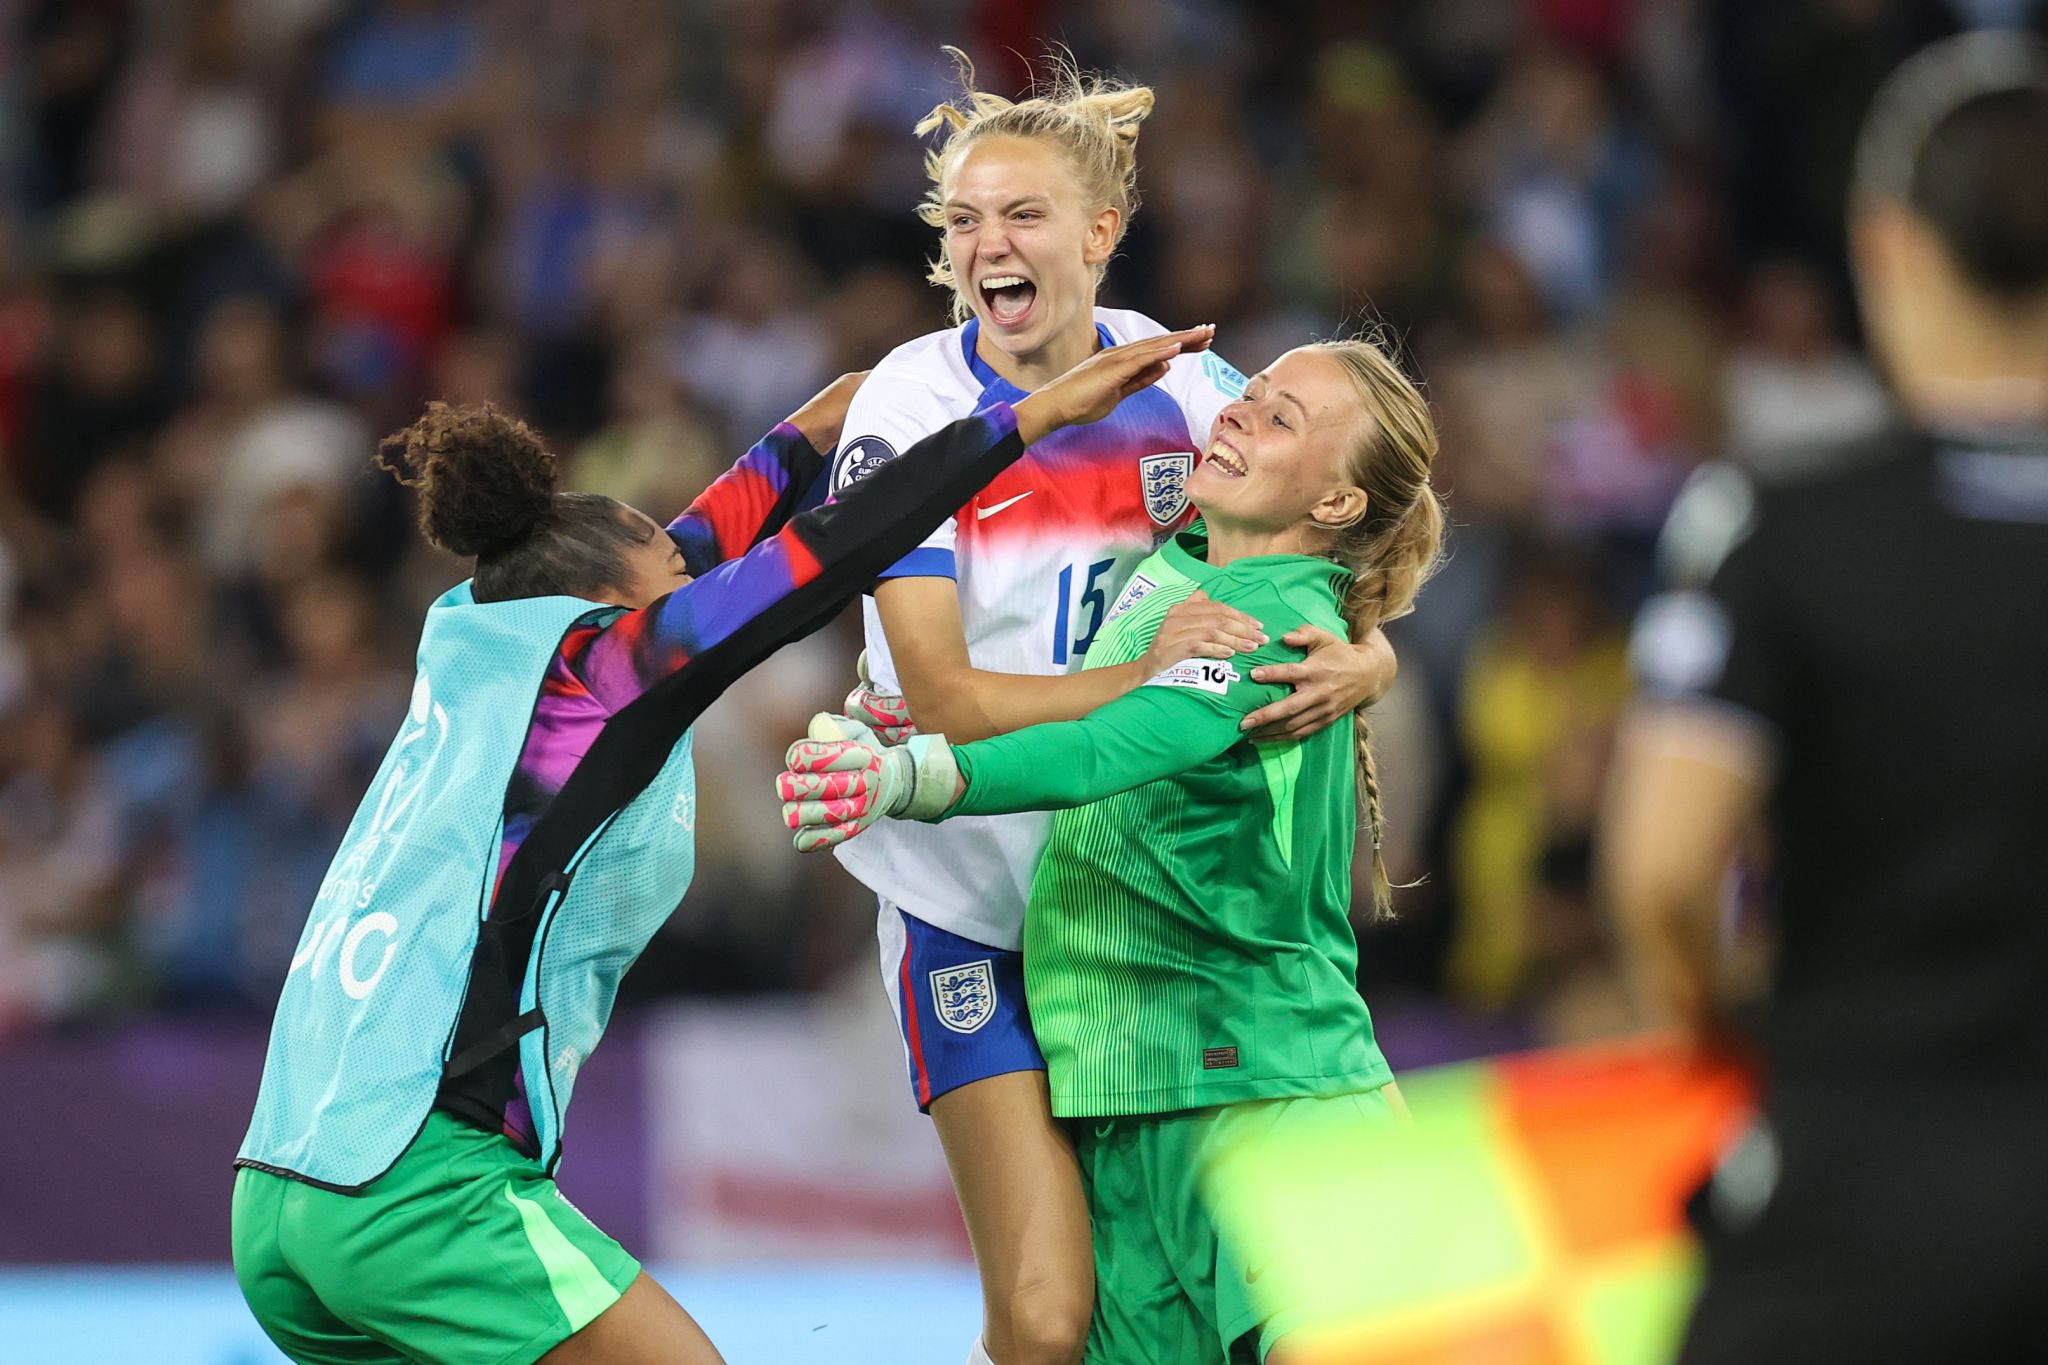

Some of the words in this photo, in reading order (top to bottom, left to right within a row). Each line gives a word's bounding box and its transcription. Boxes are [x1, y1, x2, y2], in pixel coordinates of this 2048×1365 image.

[1053, 557, 1117, 665] 15
[1167, 668, 1199, 677] ATION
[1201, 665, 1226, 684] 10
